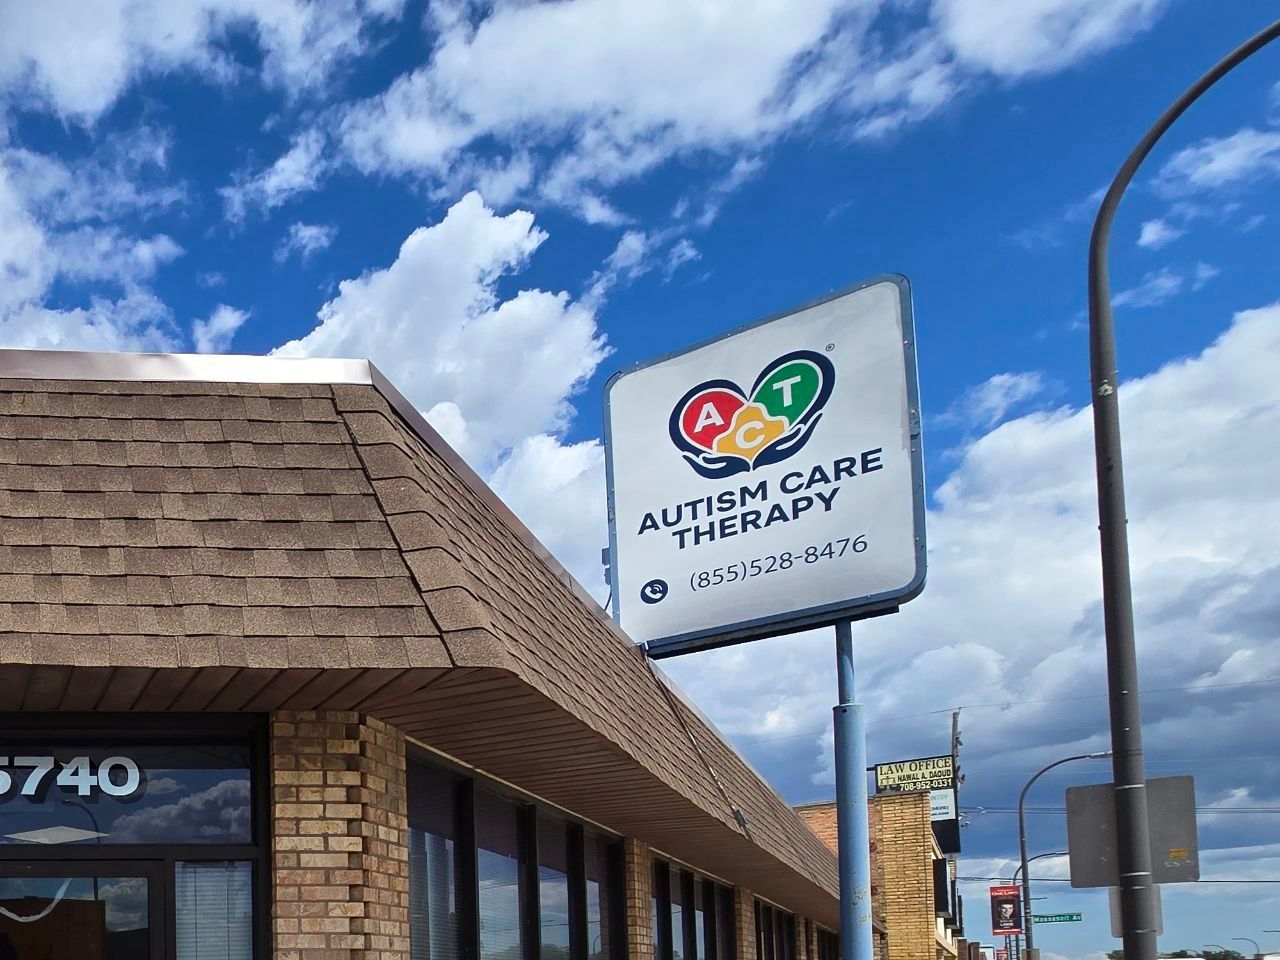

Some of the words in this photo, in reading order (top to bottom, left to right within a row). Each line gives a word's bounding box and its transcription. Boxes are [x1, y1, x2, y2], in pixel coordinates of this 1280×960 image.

[637, 479, 768, 536] AUTISM
[779, 447, 884, 495] CARE
[671, 487, 840, 550] THERAPY
[689, 533, 868, 591] (855)528-8476
[880, 764, 905, 775] LAW
[909, 758, 951, 771] OFFICE
[897, 773, 919, 782] NAWAL
[929, 769, 951, 778] DAOUD
[900, 779, 952, 791] 708-952-0331
